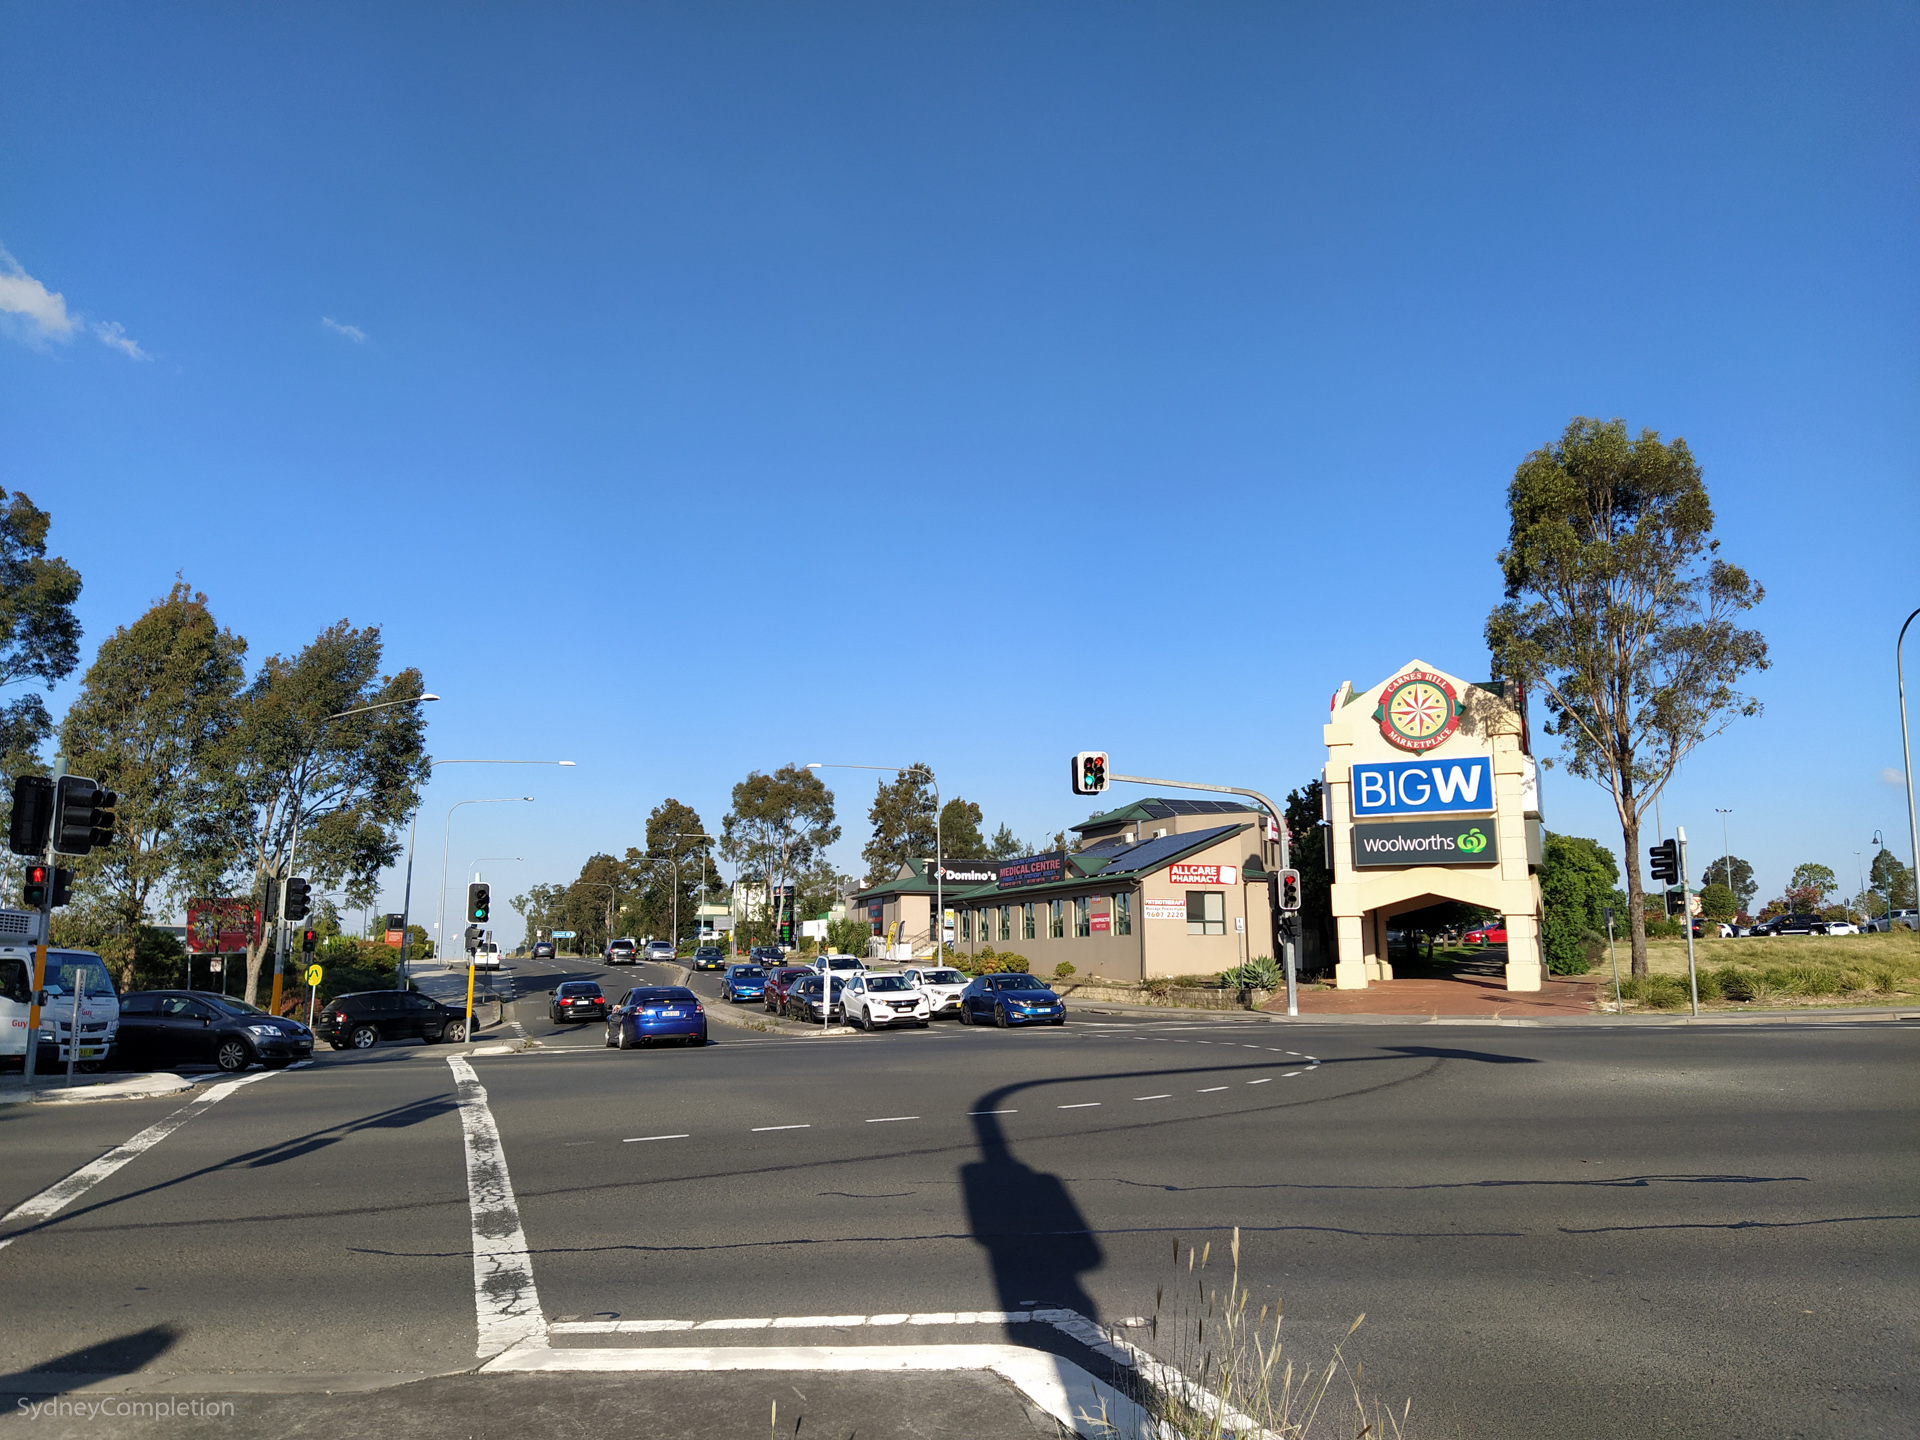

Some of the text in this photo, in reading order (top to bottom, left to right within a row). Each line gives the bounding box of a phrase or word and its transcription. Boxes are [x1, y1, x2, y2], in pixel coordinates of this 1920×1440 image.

[1387, 672, 1447, 692] CARNES HILL
[1388, 727, 1452, 749] MARKETPLACE
[1363, 834, 1455, 853] Woolworths
[946, 869, 997, 881] Domino's
[1000, 864, 1030, 878] MEDICAL
[1031, 859, 1061, 872] CENTRE
[1171, 875, 1218, 883] PHARMACY
[12, 1019, 28, 1029] Guy
